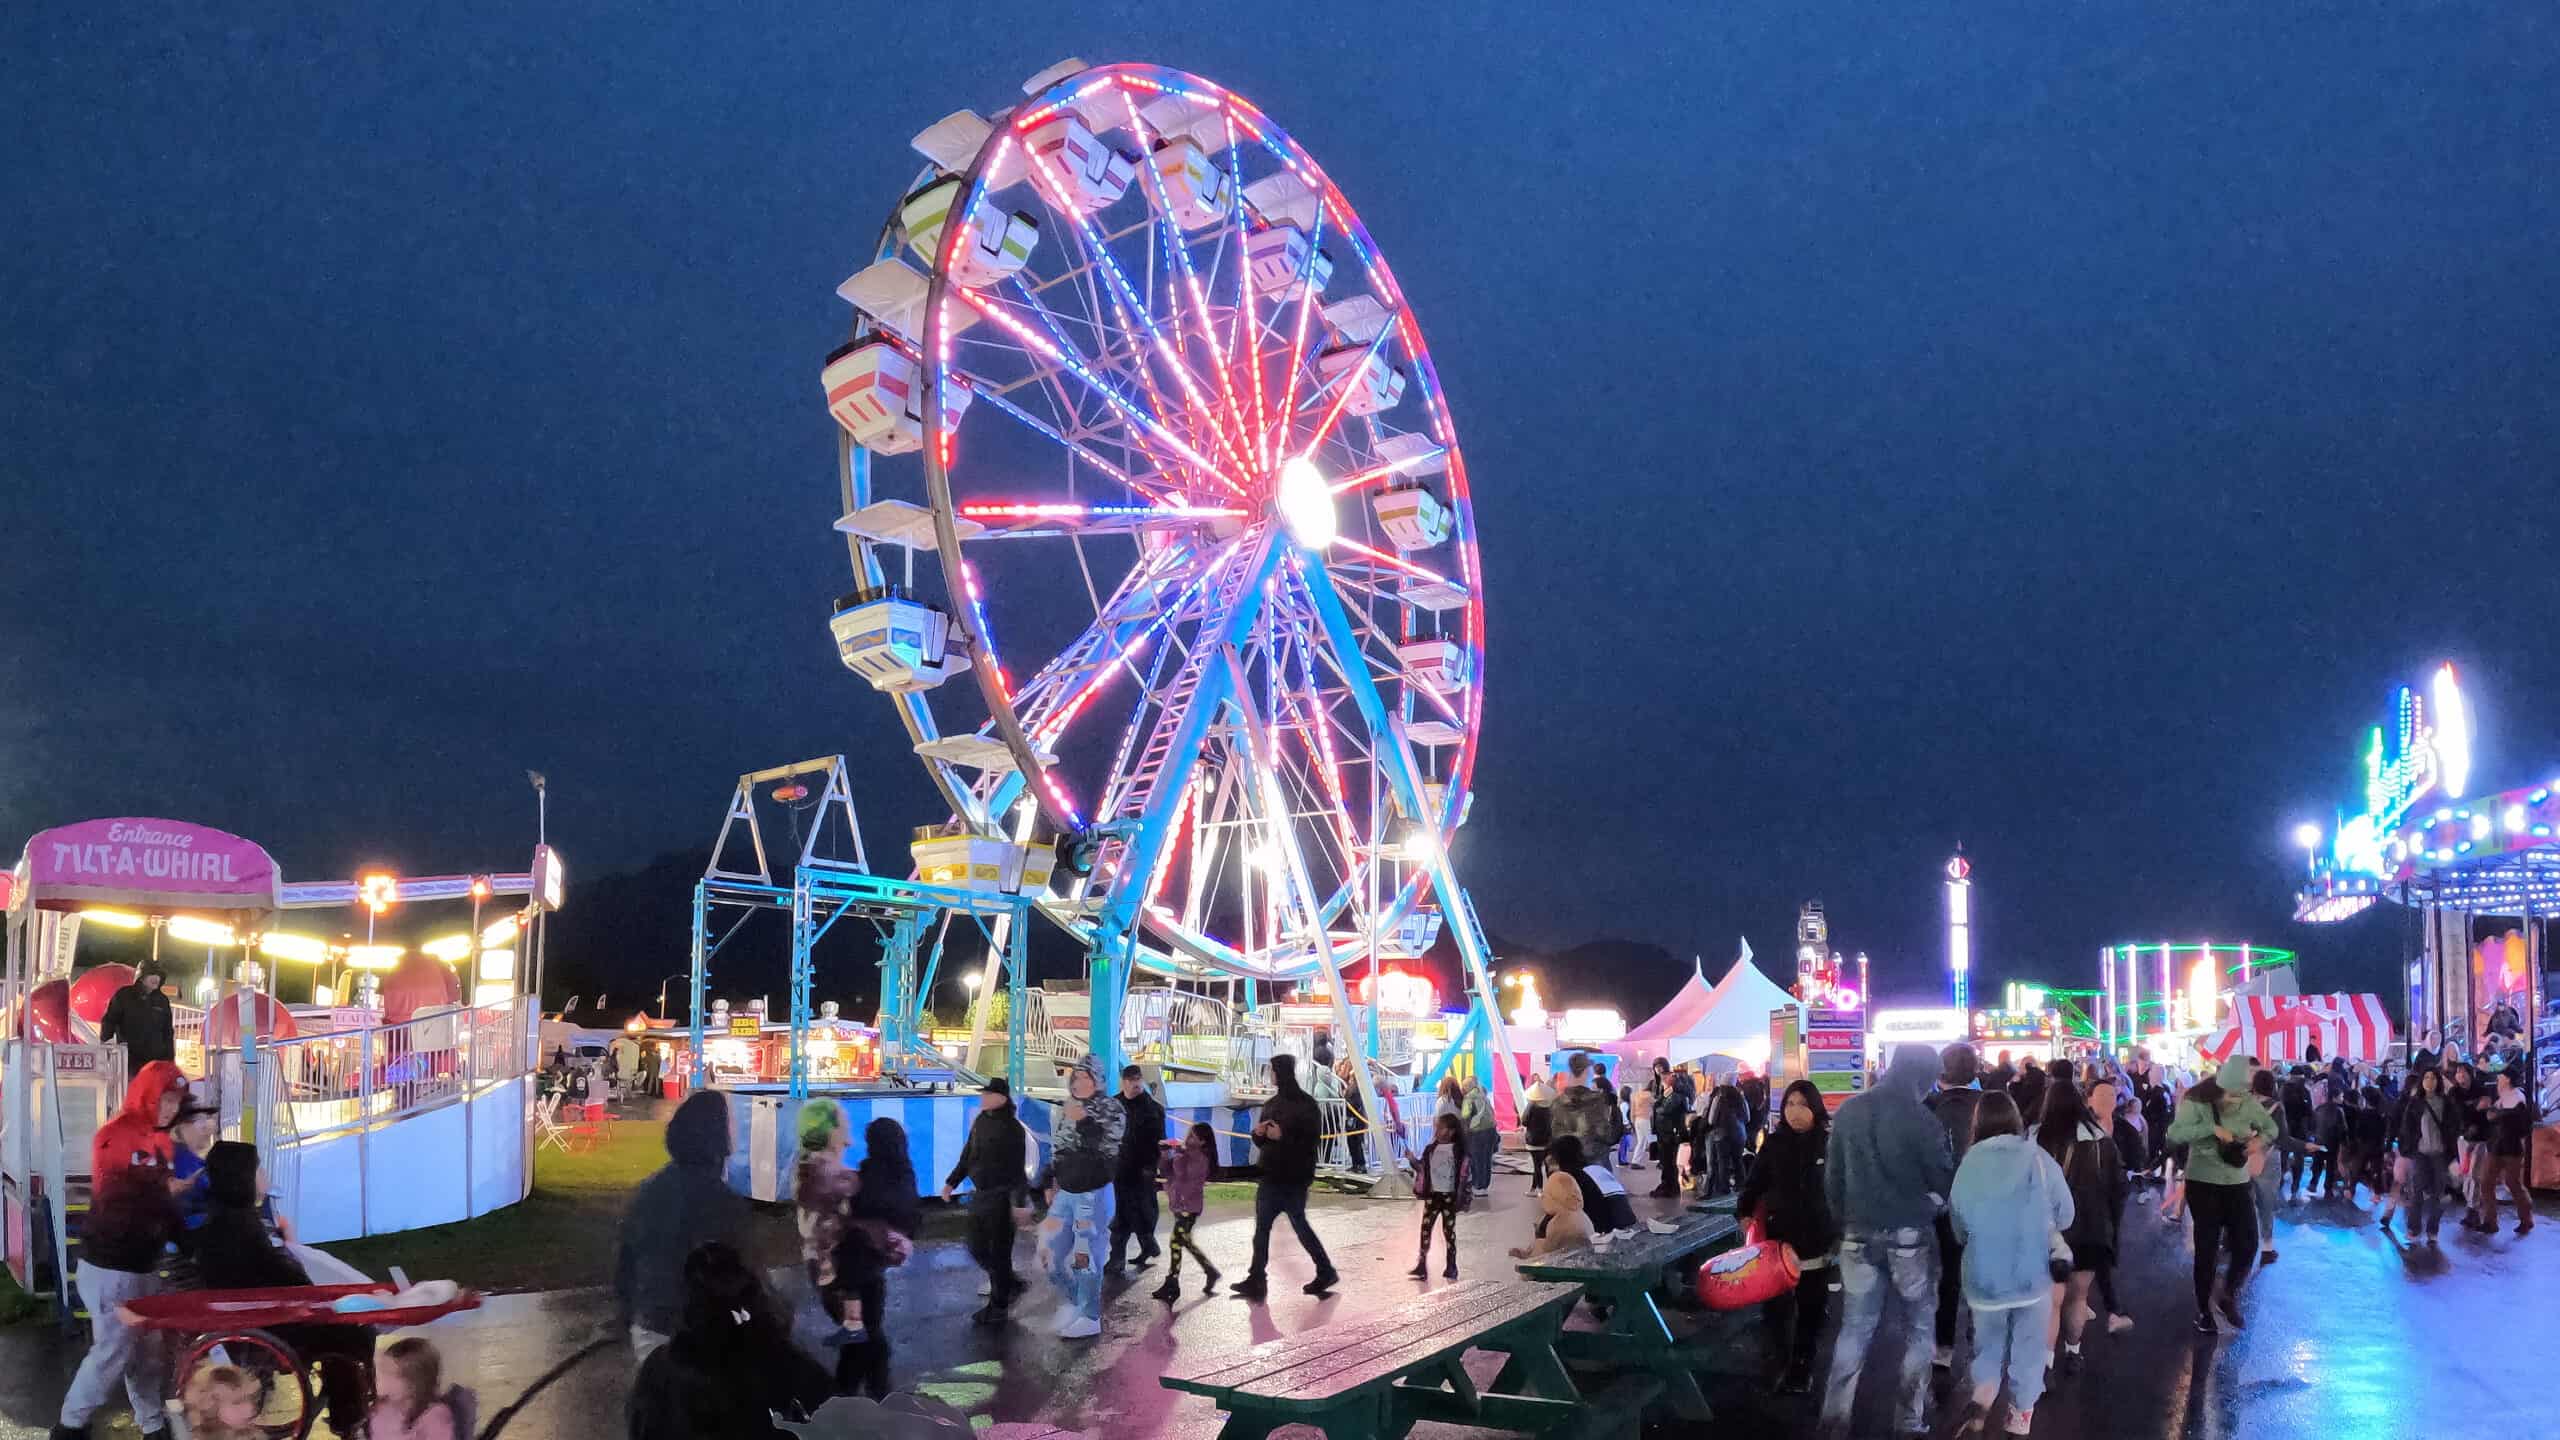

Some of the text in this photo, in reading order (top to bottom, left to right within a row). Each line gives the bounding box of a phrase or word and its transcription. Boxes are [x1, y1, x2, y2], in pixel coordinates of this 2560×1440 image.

[107, 823, 193, 849] Entrance
[53, 842, 239, 882] TILT-A-WHIRL
[1986, 1016, 2049, 1029] TICKETS
